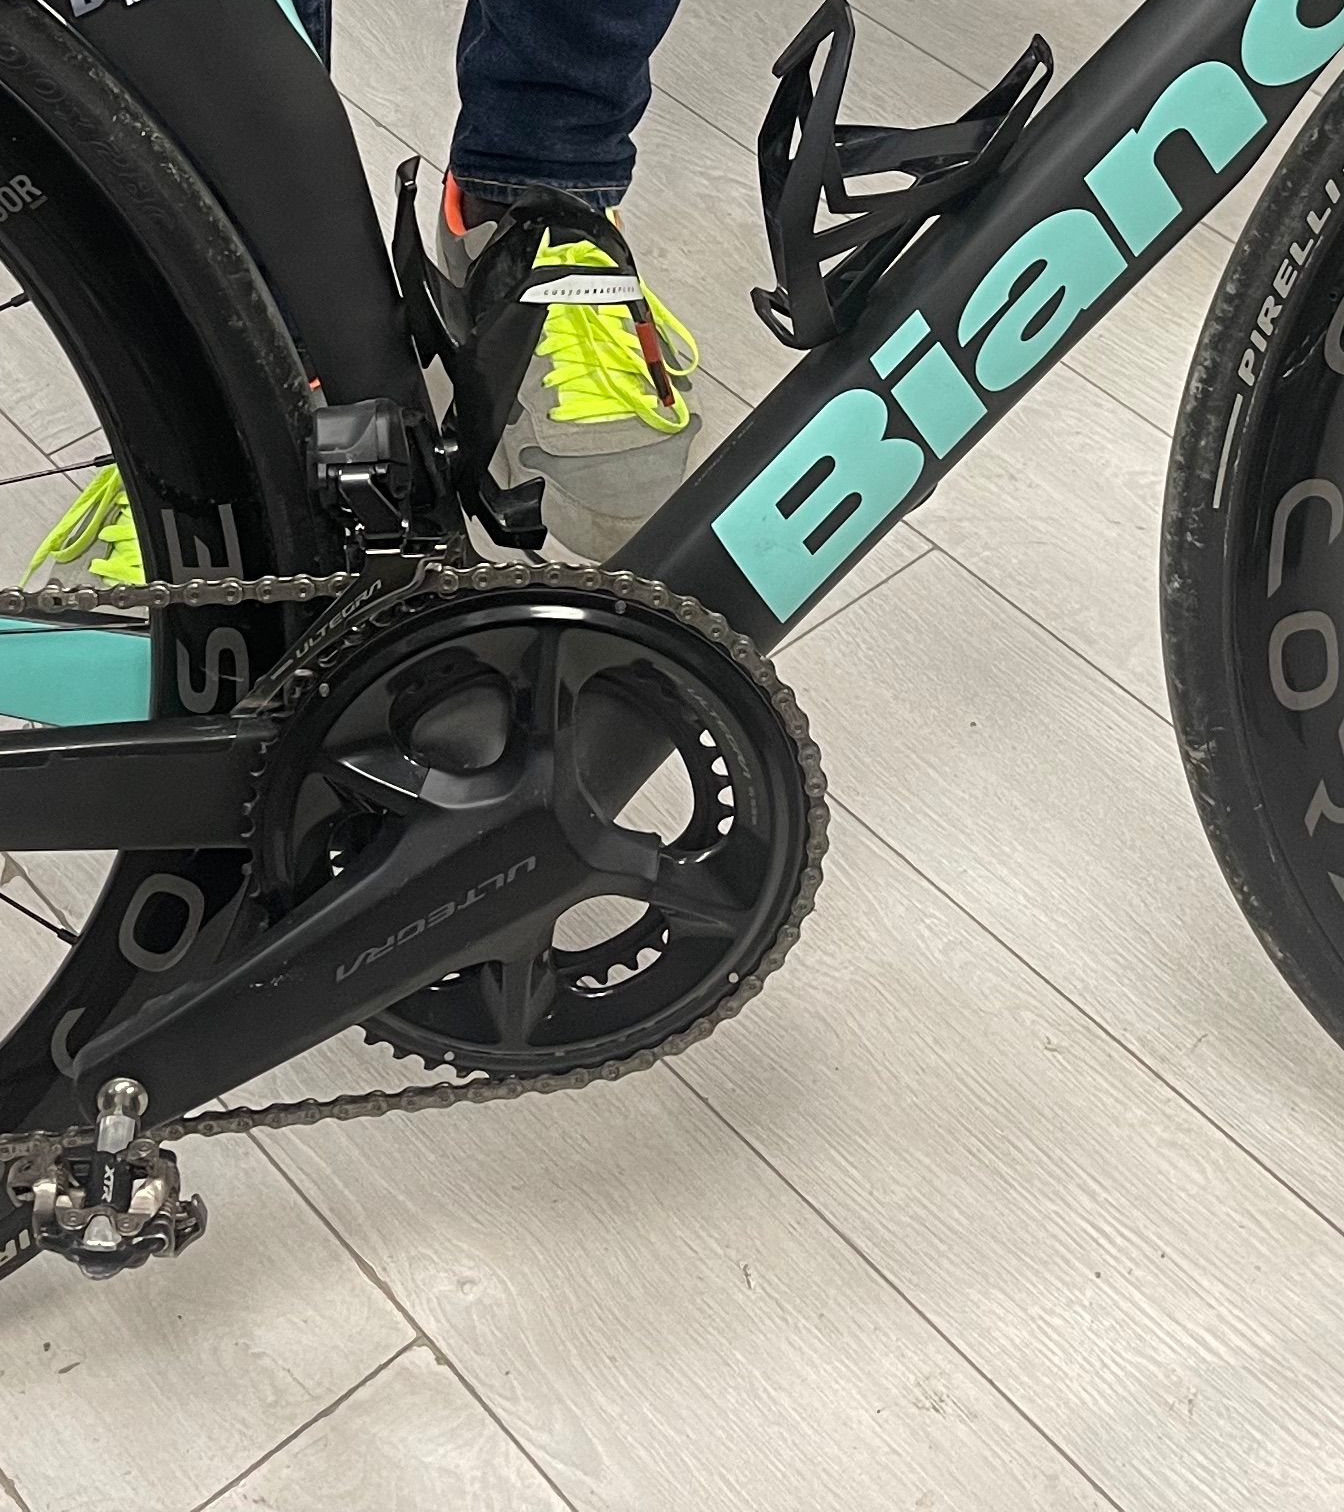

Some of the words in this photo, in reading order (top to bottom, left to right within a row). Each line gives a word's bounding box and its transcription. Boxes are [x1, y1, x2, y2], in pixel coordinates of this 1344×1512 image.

[1238, 178, 1343, 387] PIRELLI
[296, 579, 382, 658] ULTEGRA
[335, 855, 537, 984] ULTEGRA
[101, 1164, 115, 1203] XTR
